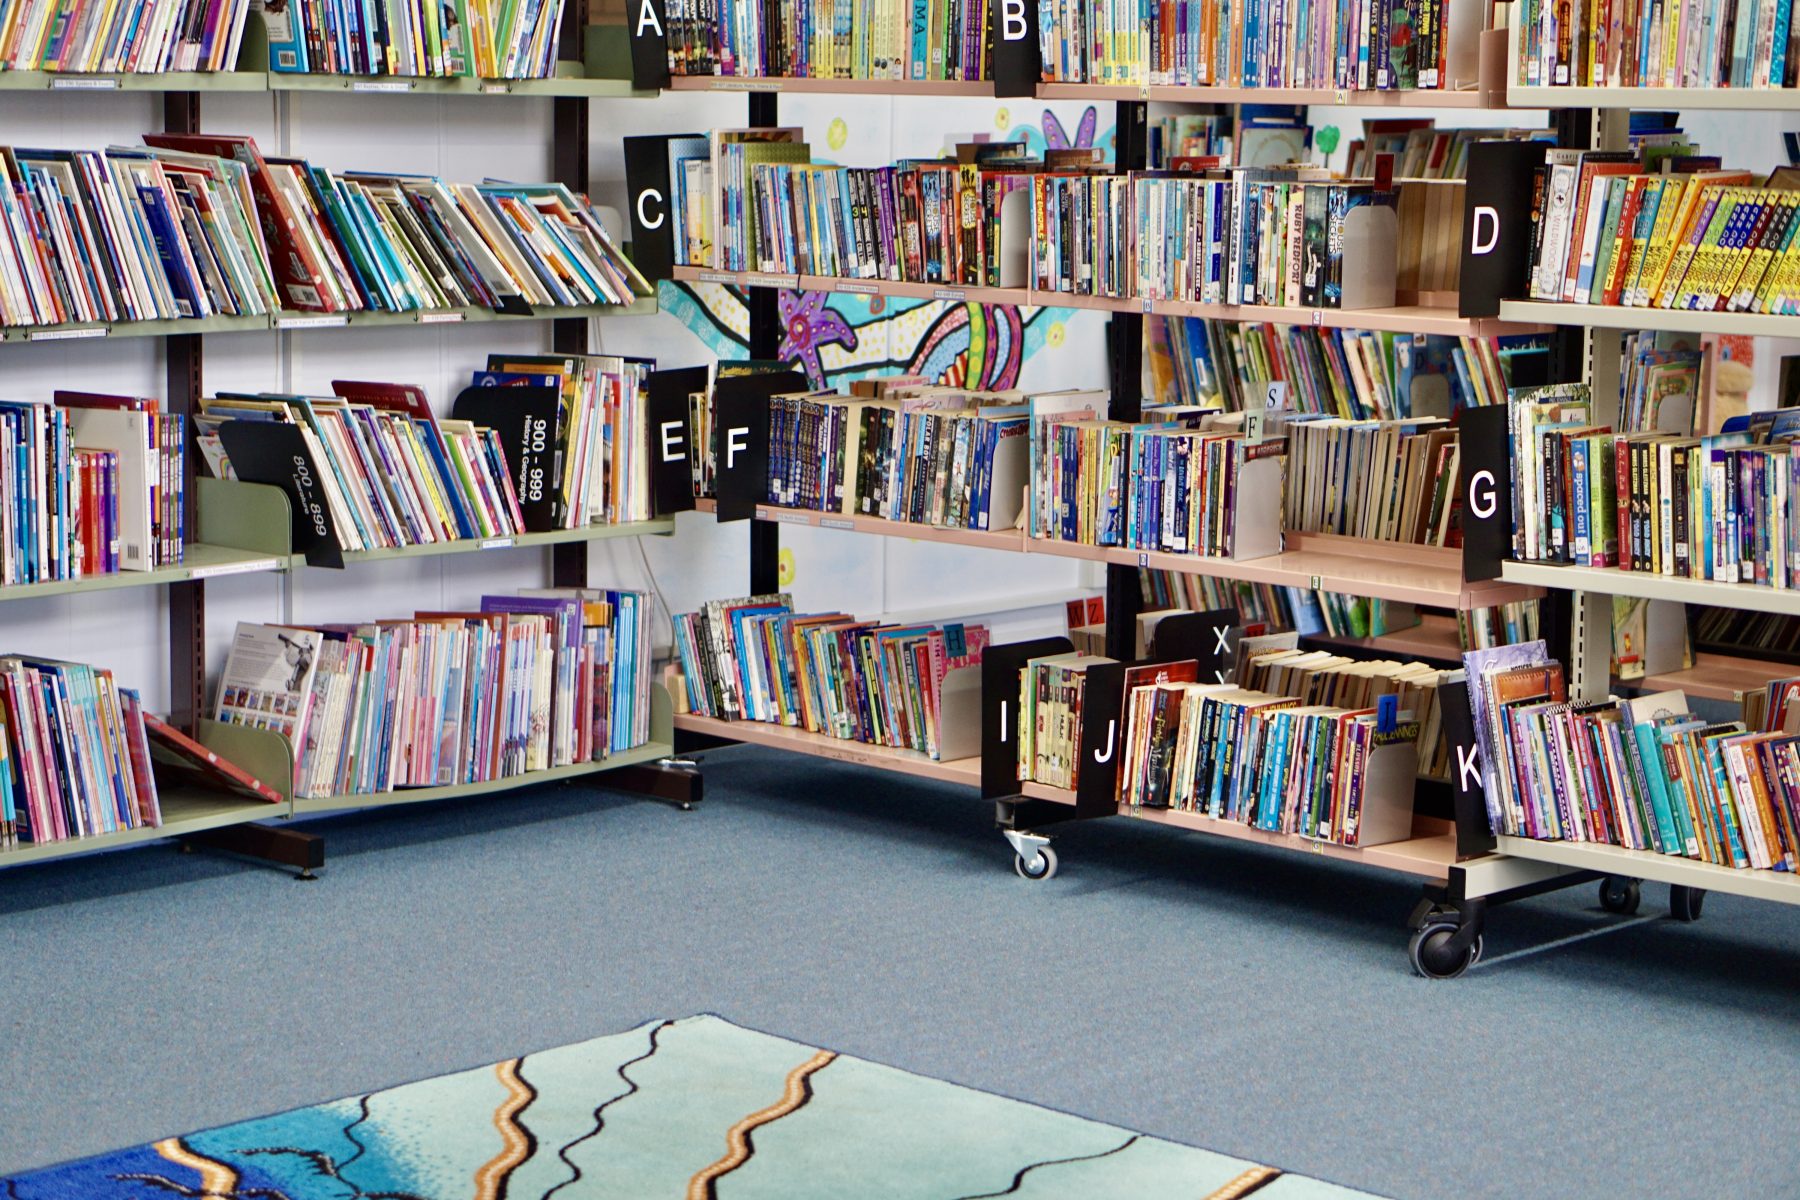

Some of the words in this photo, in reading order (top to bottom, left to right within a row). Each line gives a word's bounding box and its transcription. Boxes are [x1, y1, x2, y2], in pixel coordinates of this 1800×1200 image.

[637, 0, 662, 36] A
[915, 0, 926, 35] MA
[1001, 0, 1027, 41] B
[637, 189, 665, 230] C
[852, 207, 859, 217] 3
[861, 206, 868, 217] 4
[1294, 204, 1302, 233] RUBY
[1231, 205, 1239, 262] TRACKERS
[1329, 215, 1337, 254] SECRETS
[1471, 206, 1500, 255] D
[1292, 237, 1301, 285] REDFORT
[1266, 388, 1277, 409] S
[522, 415, 533, 446] History
[532, 419, 546, 453] 900
[661, 420, 686, 462] E
[924, 416, 932, 442] POLAR
[1247, 416, 1258, 439] F
[522, 446, 530, 455] &
[727, 426, 749, 469] F
[922, 445, 930, 461] BOY
[294, 456, 313, 487] 800
[311, 503, 327, 536] 899
[519, 456, 530, 505] Geography
[529, 467, 544, 501] 999
[1469, 470, 1498, 519] G
[1574, 473, 1587, 513] spaced
[1578, 515, 1586, 533] out
[1087, 603, 1099, 624] Z
[947, 630, 963, 651] H
[1212, 624, 1232, 655] X
[1094, 719, 1115, 763] J
[1353, 744, 1362, 776] BLOSSOM
[1456, 743, 1483, 792] K
